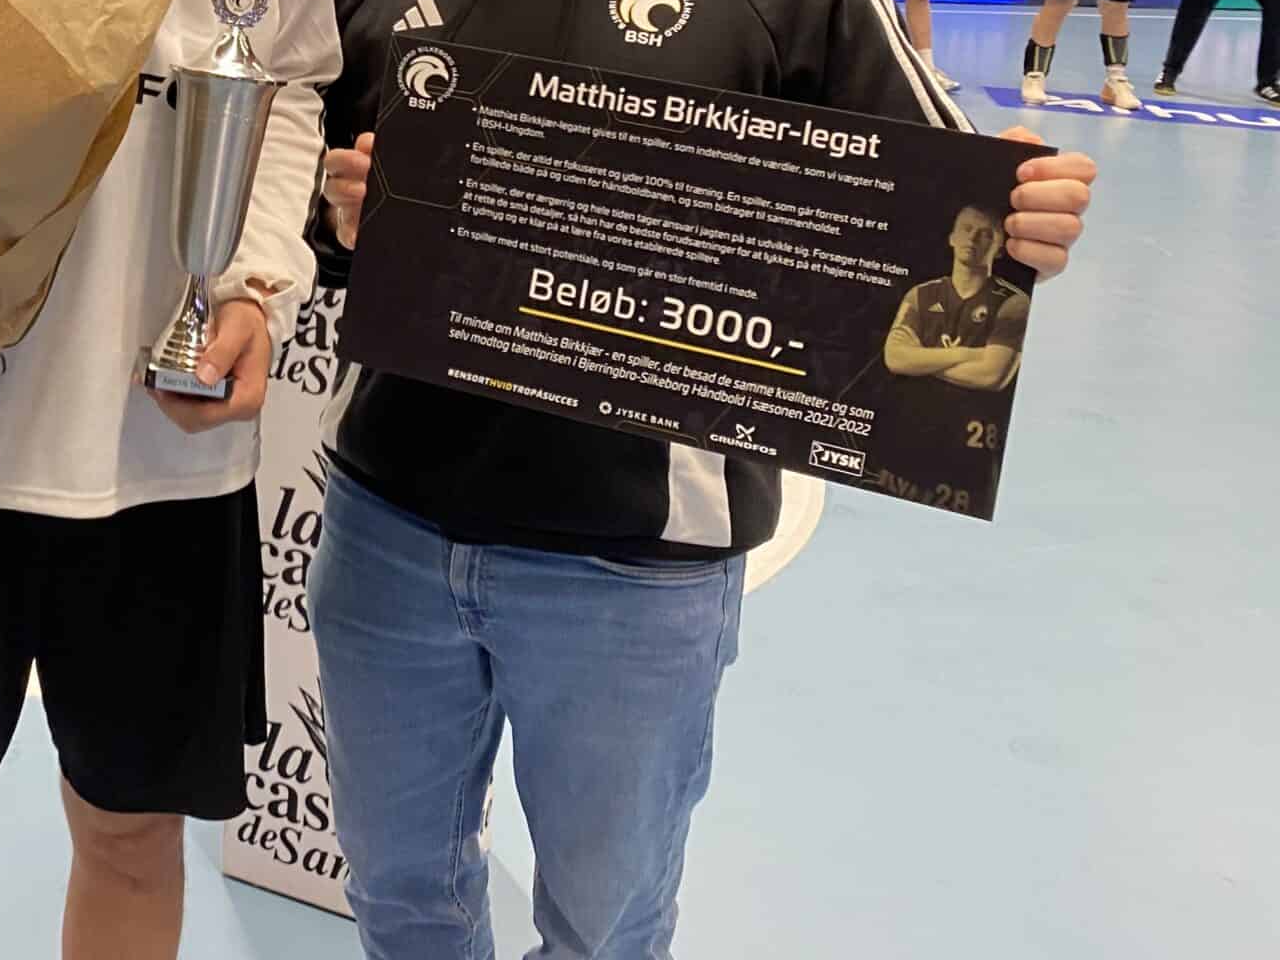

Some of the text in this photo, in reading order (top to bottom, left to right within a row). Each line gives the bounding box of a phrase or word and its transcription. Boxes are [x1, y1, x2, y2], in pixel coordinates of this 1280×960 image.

[624, 29, 664, 47] BSH
[408, 96, 436, 110] BSH
[530, 73, 878, 157] Matthias Birkkjær-legat
[529, 269, 802, 356] Beløb: 3000,-
[448, 328, 871, 436] selv modtog talentprisen i Bjerringbro-Silkeborg Håndbold i sæsonen 2021/2022
[450, 310, 462, 323] Til
[462, 316, 494, 331] minde
[495, 324, 512, 335] om
[513, 326, 558, 346] Matthias
[560, 337, 604, 356] Birkkjær
[611, 351, 626, 362] en
[627, 355, 660, 371] spiller,
[663, 362, 682, 374] der
[682, 365, 717, 383] besad
[717, 374, 732, 387] de
[733, 379, 774, 396] samme
[775, 387, 829, 410] kvaliteter,
[831, 402, 848, 416] og
[848, 406, 874, 419] som
[615, 408, 679, 429] JYSKE BANK
[710, 434, 776, 455] GRUNDFOS
[820, 447, 860, 469] JYSK
[258, 720, 313, 784] la
[245, 771, 337, 836] cas
